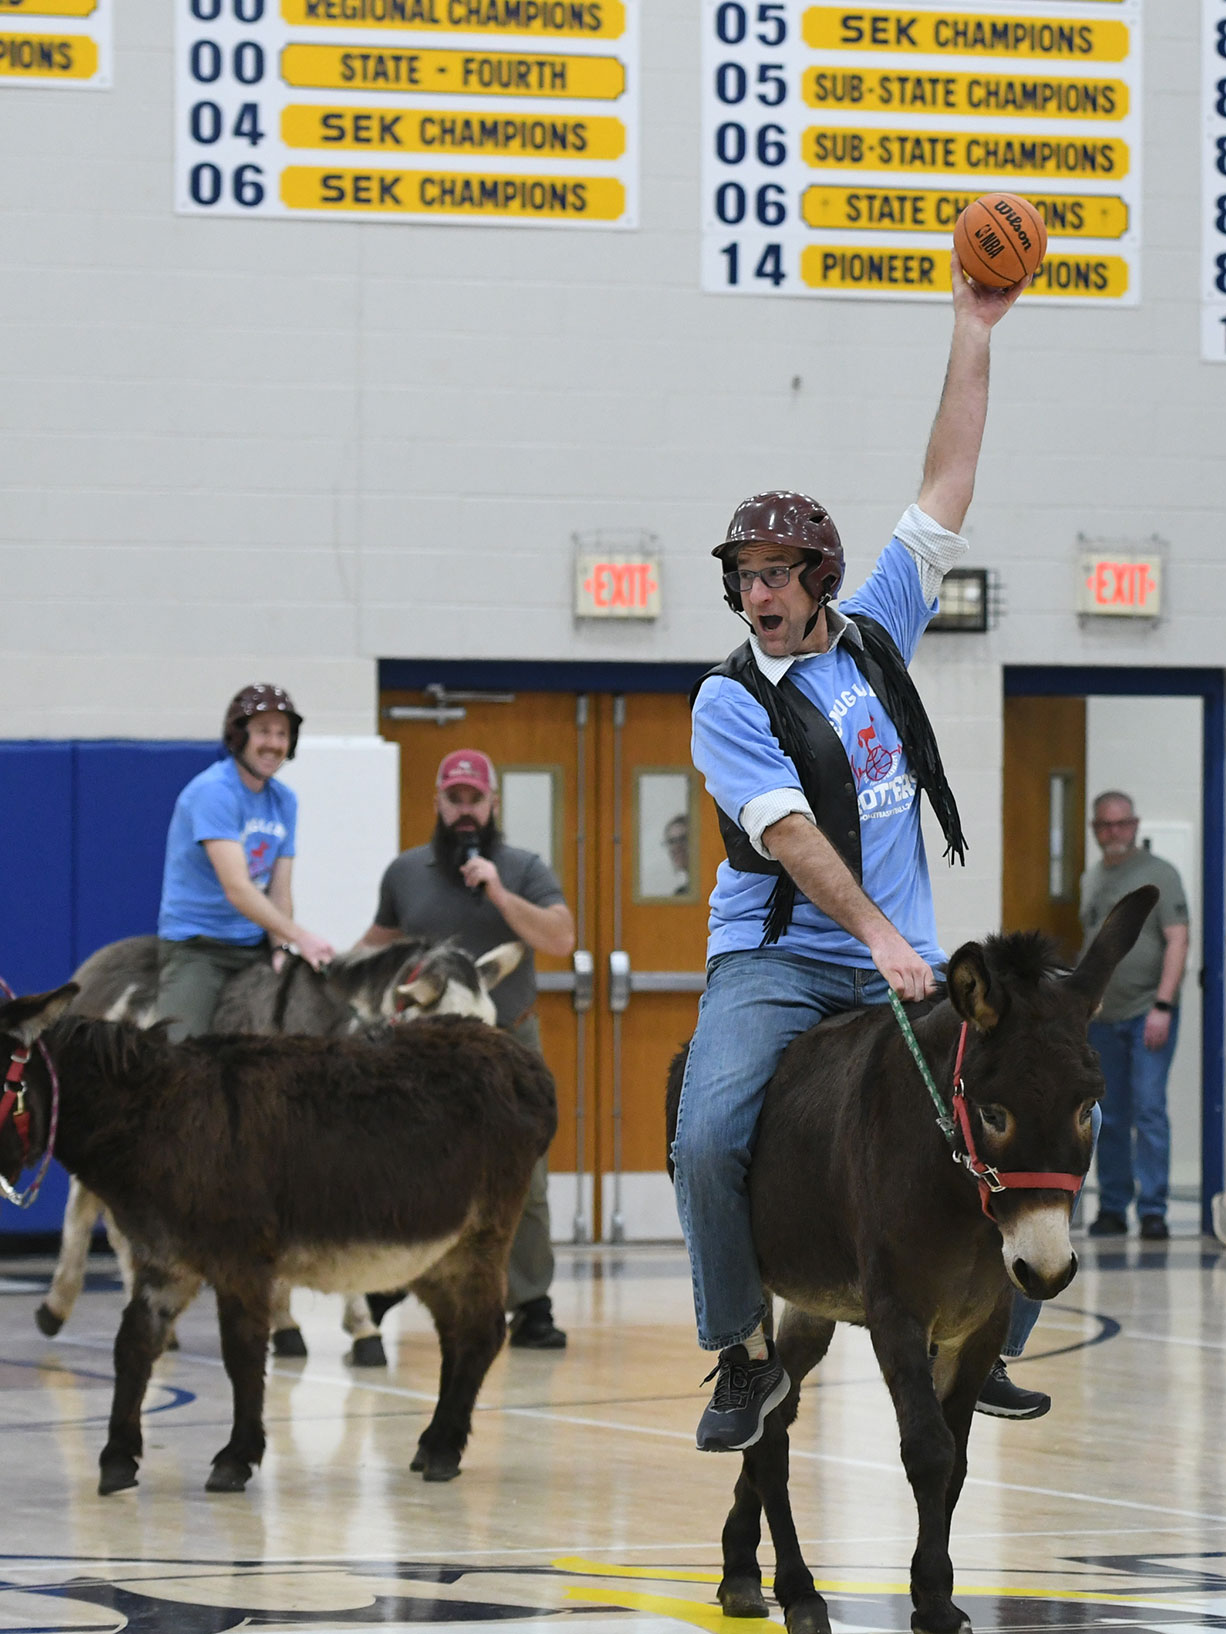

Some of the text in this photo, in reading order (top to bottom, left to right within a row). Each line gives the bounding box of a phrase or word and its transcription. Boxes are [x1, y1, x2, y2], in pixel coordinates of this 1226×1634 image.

[448, 0, 602, 31] CHAMPIONS
[716, 2, 1092, 53] 05 SEK CHAMPIONS
[190, 40, 265, 85] 00
[341, 53, 419, 84] STATE
[463, 55, 566, 89] FOURTH
[716, 62, 787, 107] 05
[968, 80, 1115, 114] CHAMPIONS
[190, 101, 587, 152] 04 SEK CHAMPIONS
[716, 122, 787, 167] 06
[967, 139, 1114, 172] CHAMPIONS
[190, 162, 586, 212] 06 SEK CHAMPIONS
[716, 182, 1084, 230] 06 STATE CHONS
[980, 231, 1006, 260] NBA
[994, 200, 1032, 253] Wilson
[722, 242, 786, 286] 14
[823, 253, 934, 284] PIONEER
[594, 563, 650, 608] EXIT
[1095, 561, 1150, 606] EXIT
